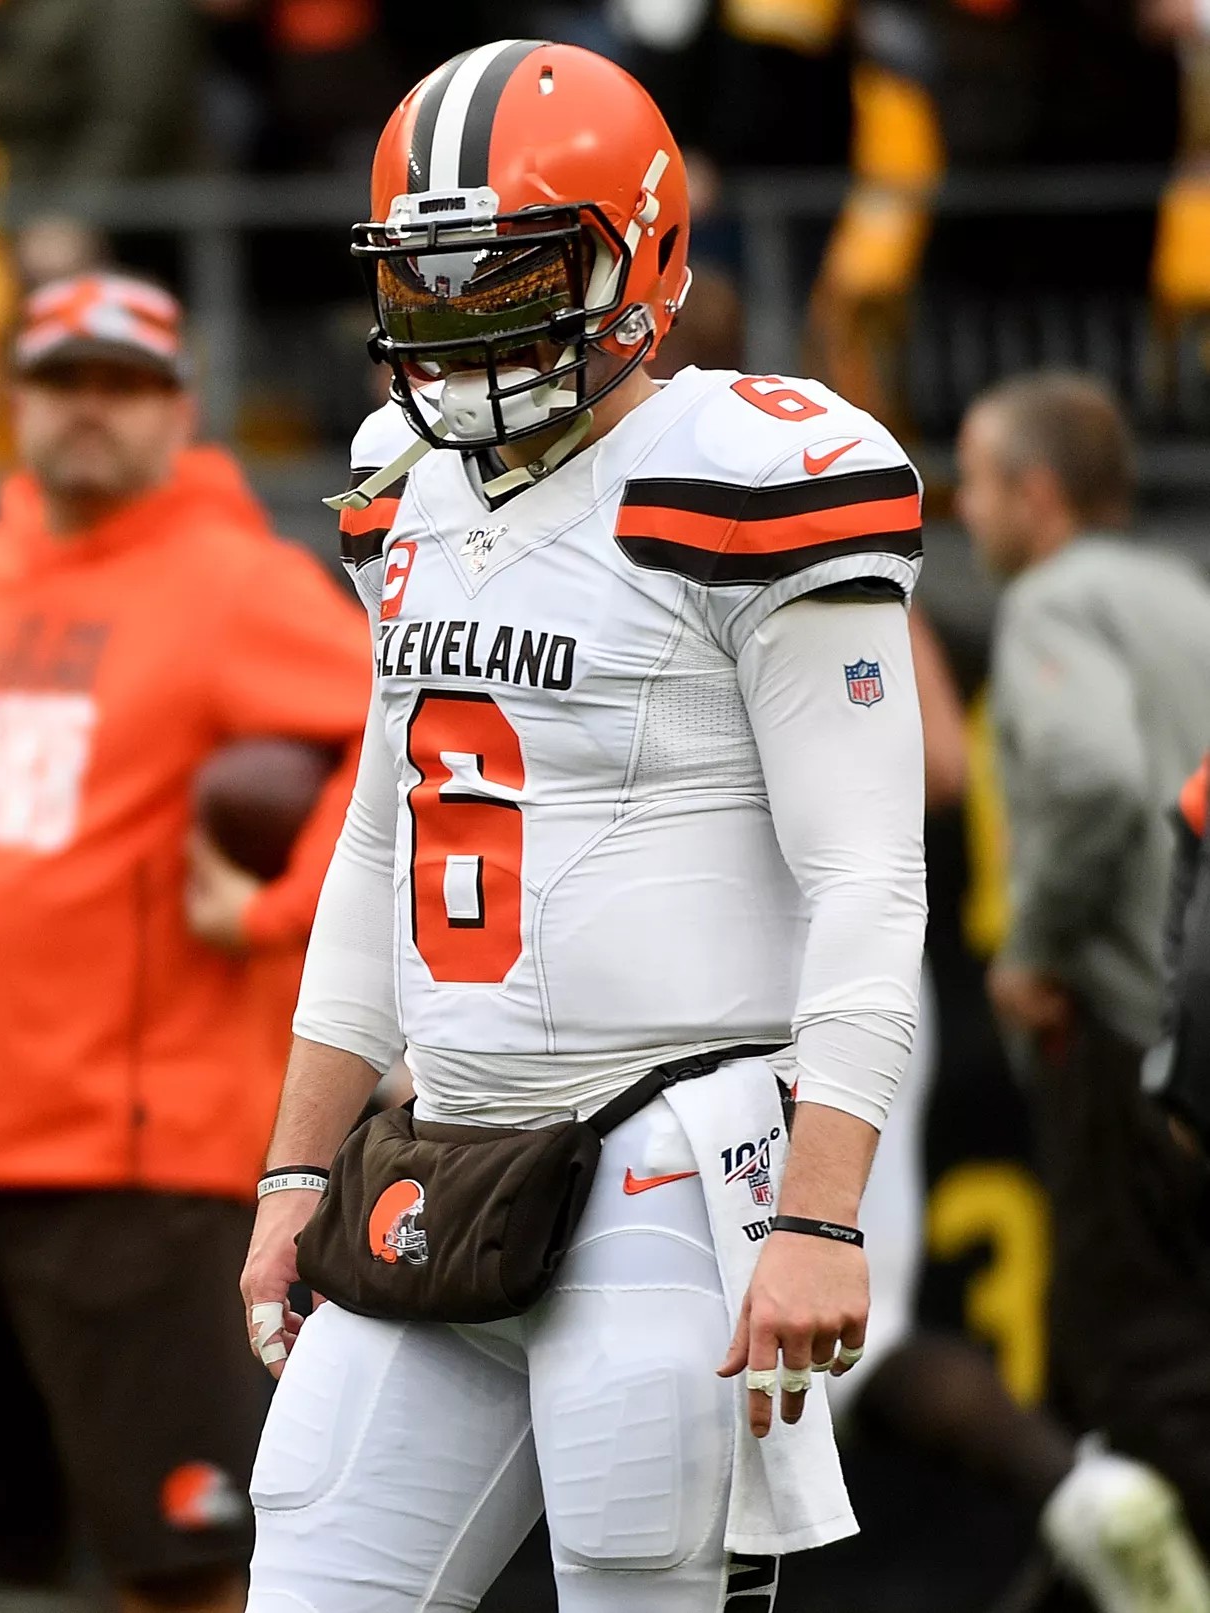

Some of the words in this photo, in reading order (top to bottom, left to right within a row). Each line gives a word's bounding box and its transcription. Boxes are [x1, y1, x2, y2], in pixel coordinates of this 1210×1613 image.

[730, 376, 828, 422] 6
[849, 678, 882, 702] NFL
[405, 687, 526, 984] 6
